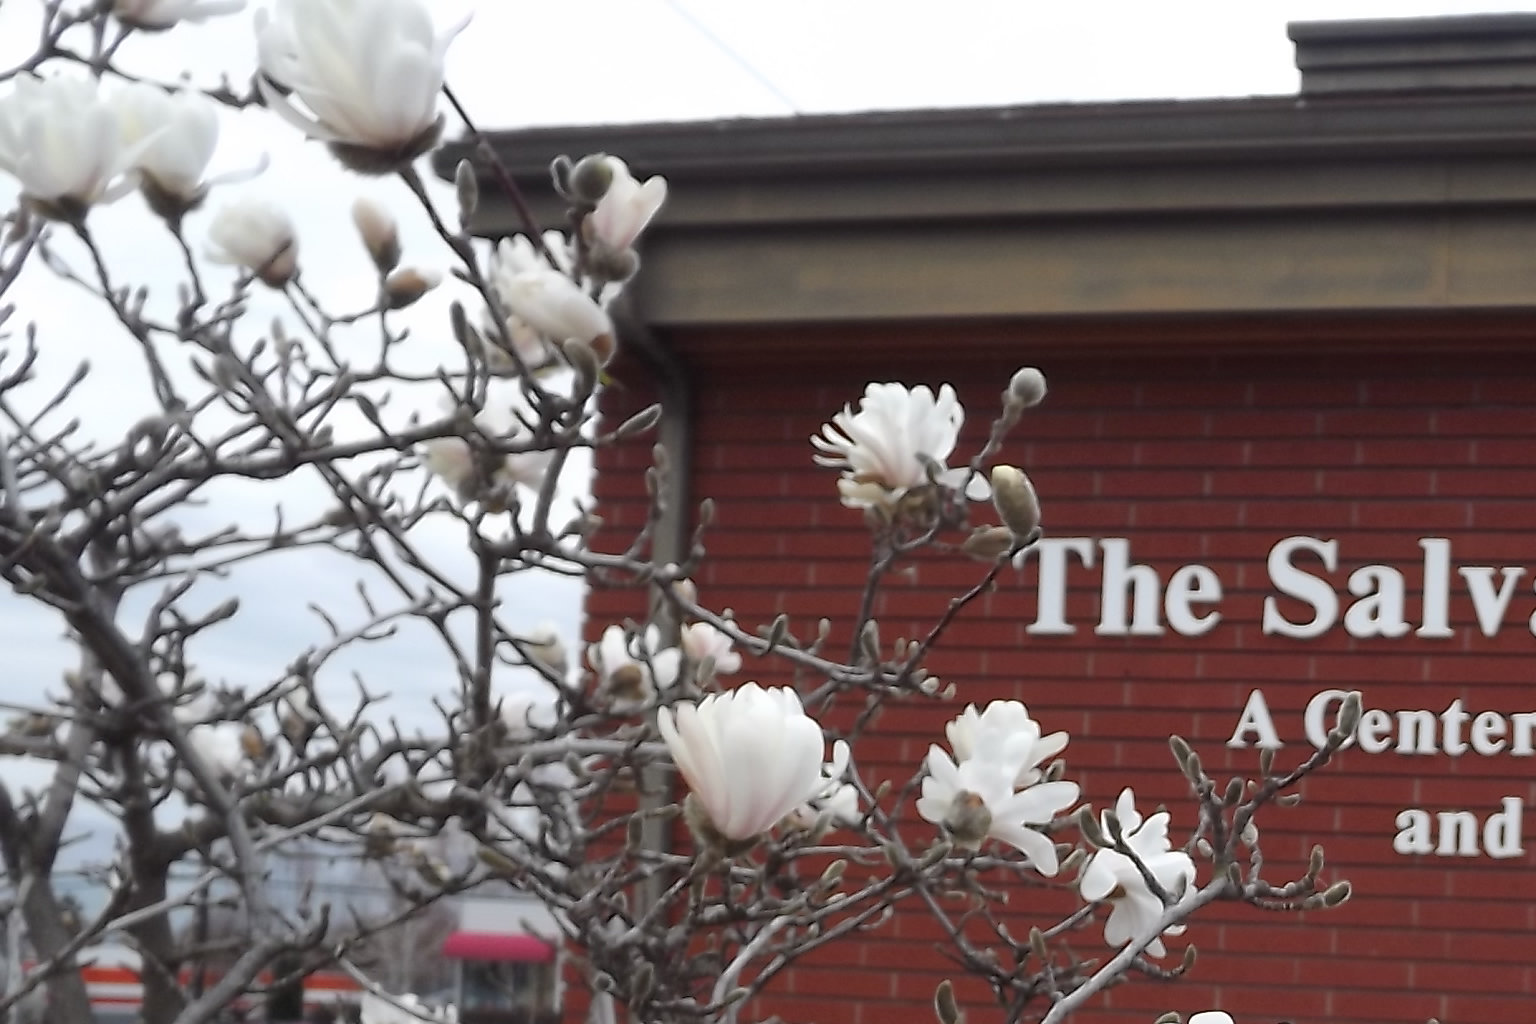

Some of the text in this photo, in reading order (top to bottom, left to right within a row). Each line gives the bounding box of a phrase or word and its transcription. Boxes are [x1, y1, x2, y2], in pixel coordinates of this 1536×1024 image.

[1012, 536, 1222, 636] The
[1227, 688, 1283, 749] A
[1393, 796, 1524, 858] and
